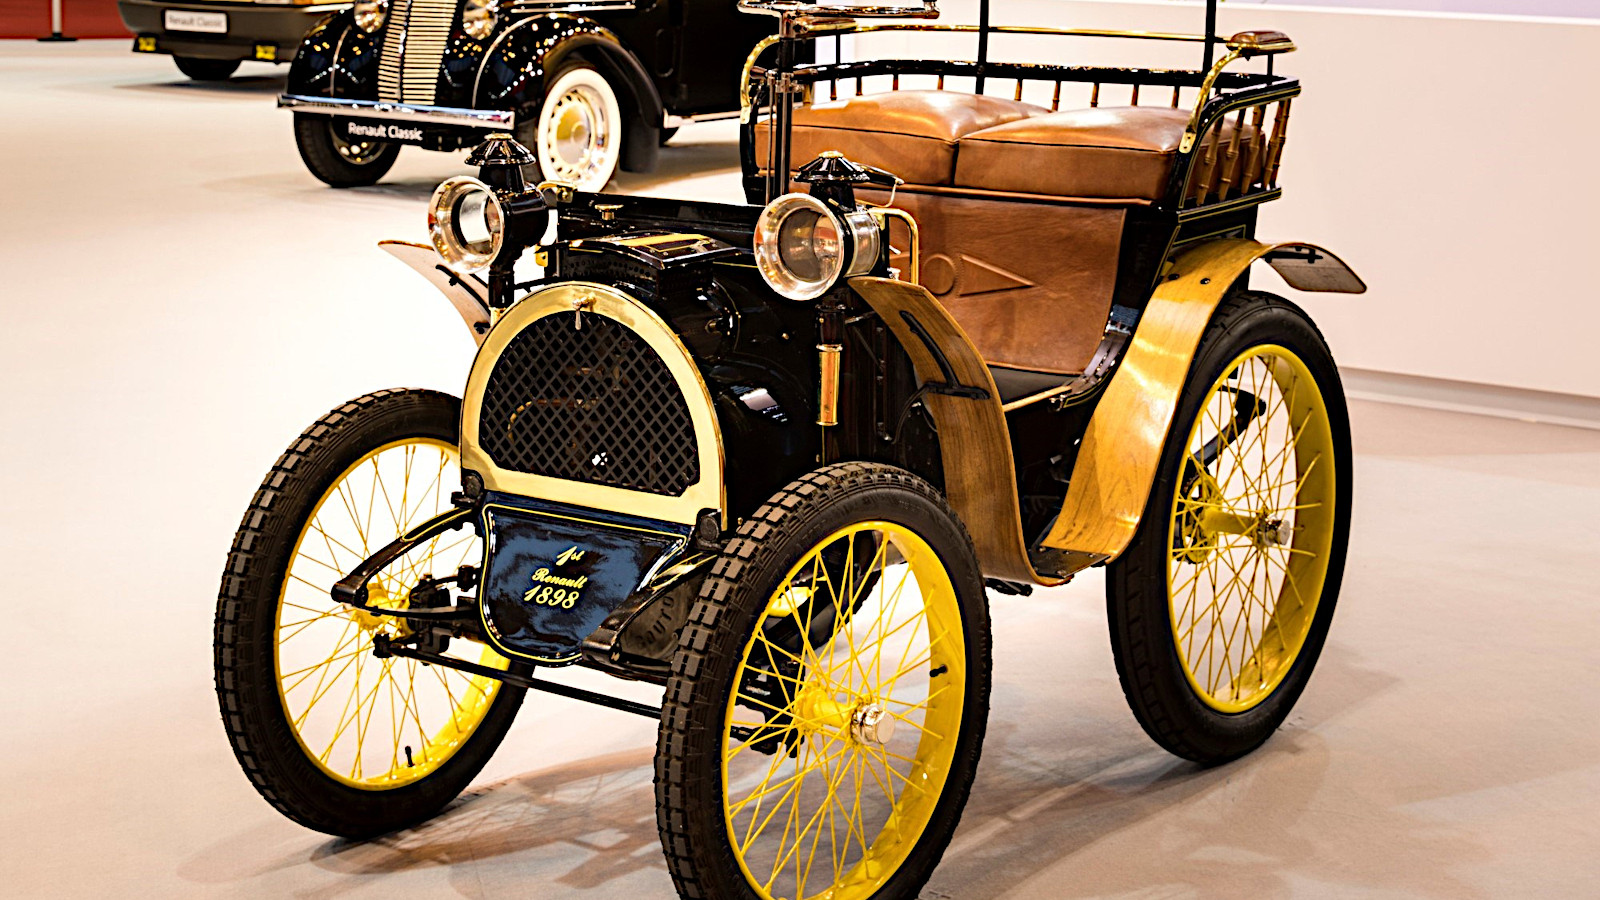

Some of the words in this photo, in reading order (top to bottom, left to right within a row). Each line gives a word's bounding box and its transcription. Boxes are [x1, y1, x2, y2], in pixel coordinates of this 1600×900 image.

[348, 122, 387, 138] Renault
[387, 125, 423, 141] Classic
[556, 546, 585, 566] 1st
[532, 568, 588, 589] Renault
[524, 585, 580, 609] 1898
